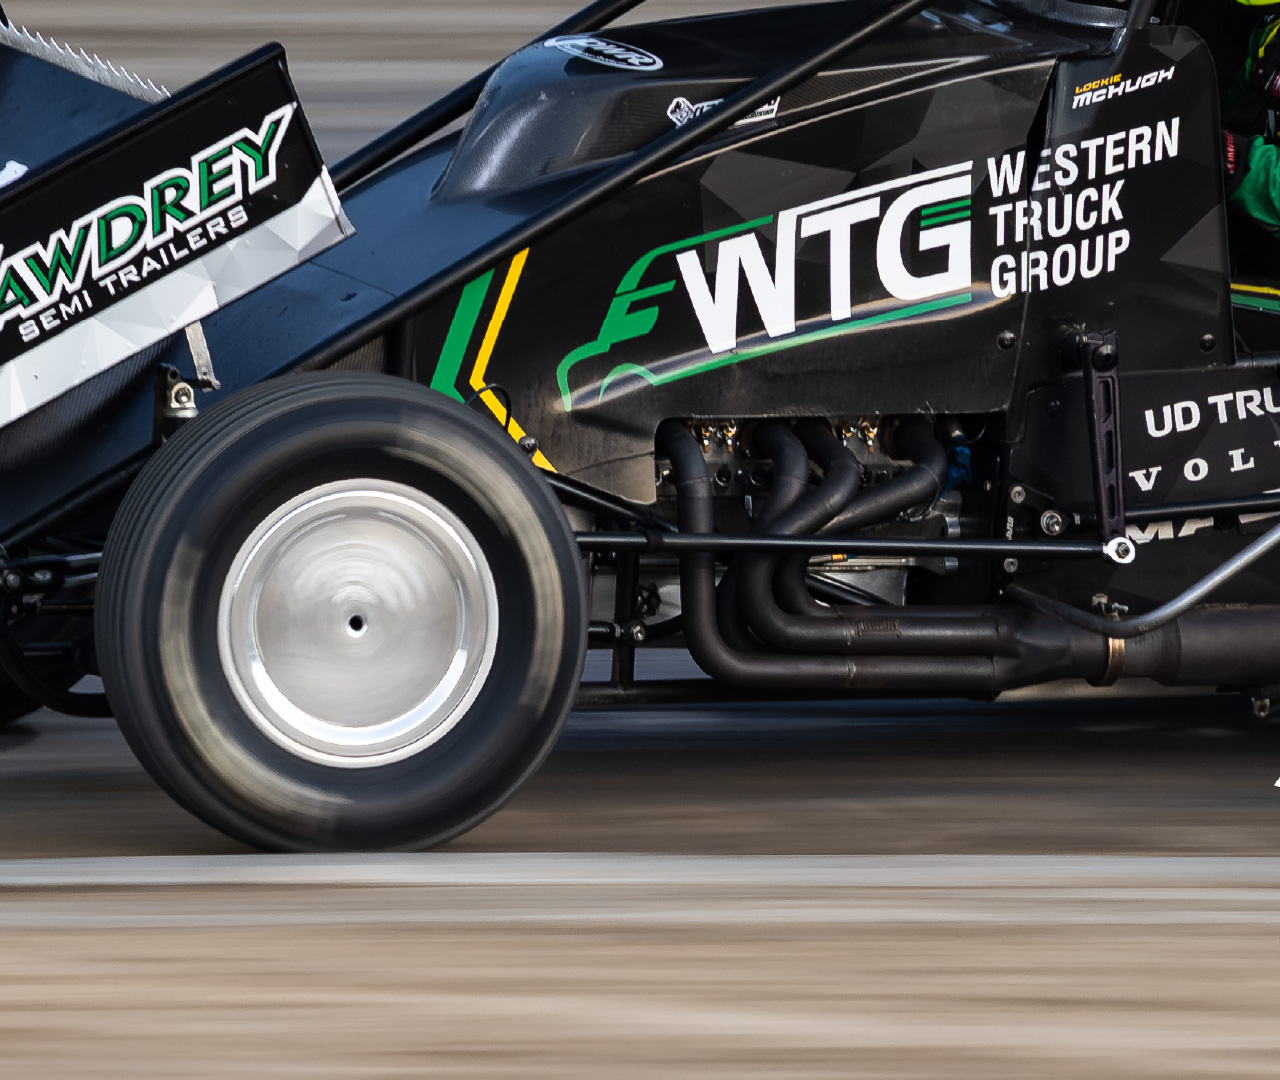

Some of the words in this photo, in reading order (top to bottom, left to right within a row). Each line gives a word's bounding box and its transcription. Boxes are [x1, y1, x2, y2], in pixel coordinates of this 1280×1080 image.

[1072, 66, 1176, 110] MCHUGH
[1075, 73, 1122, 95] LOCKIE
[987, 117, 1181, 198] WESTERN
[988, 180, 1125, 248] TRUCK
[20, 287, 94, 343] SEMI
[100, 205, 248, 295] TRAILERS
[675, 160, 973, 355] WTG
[989, 230, 1132, 299] GROUP
[1144, 400, 1201, 438] UD
